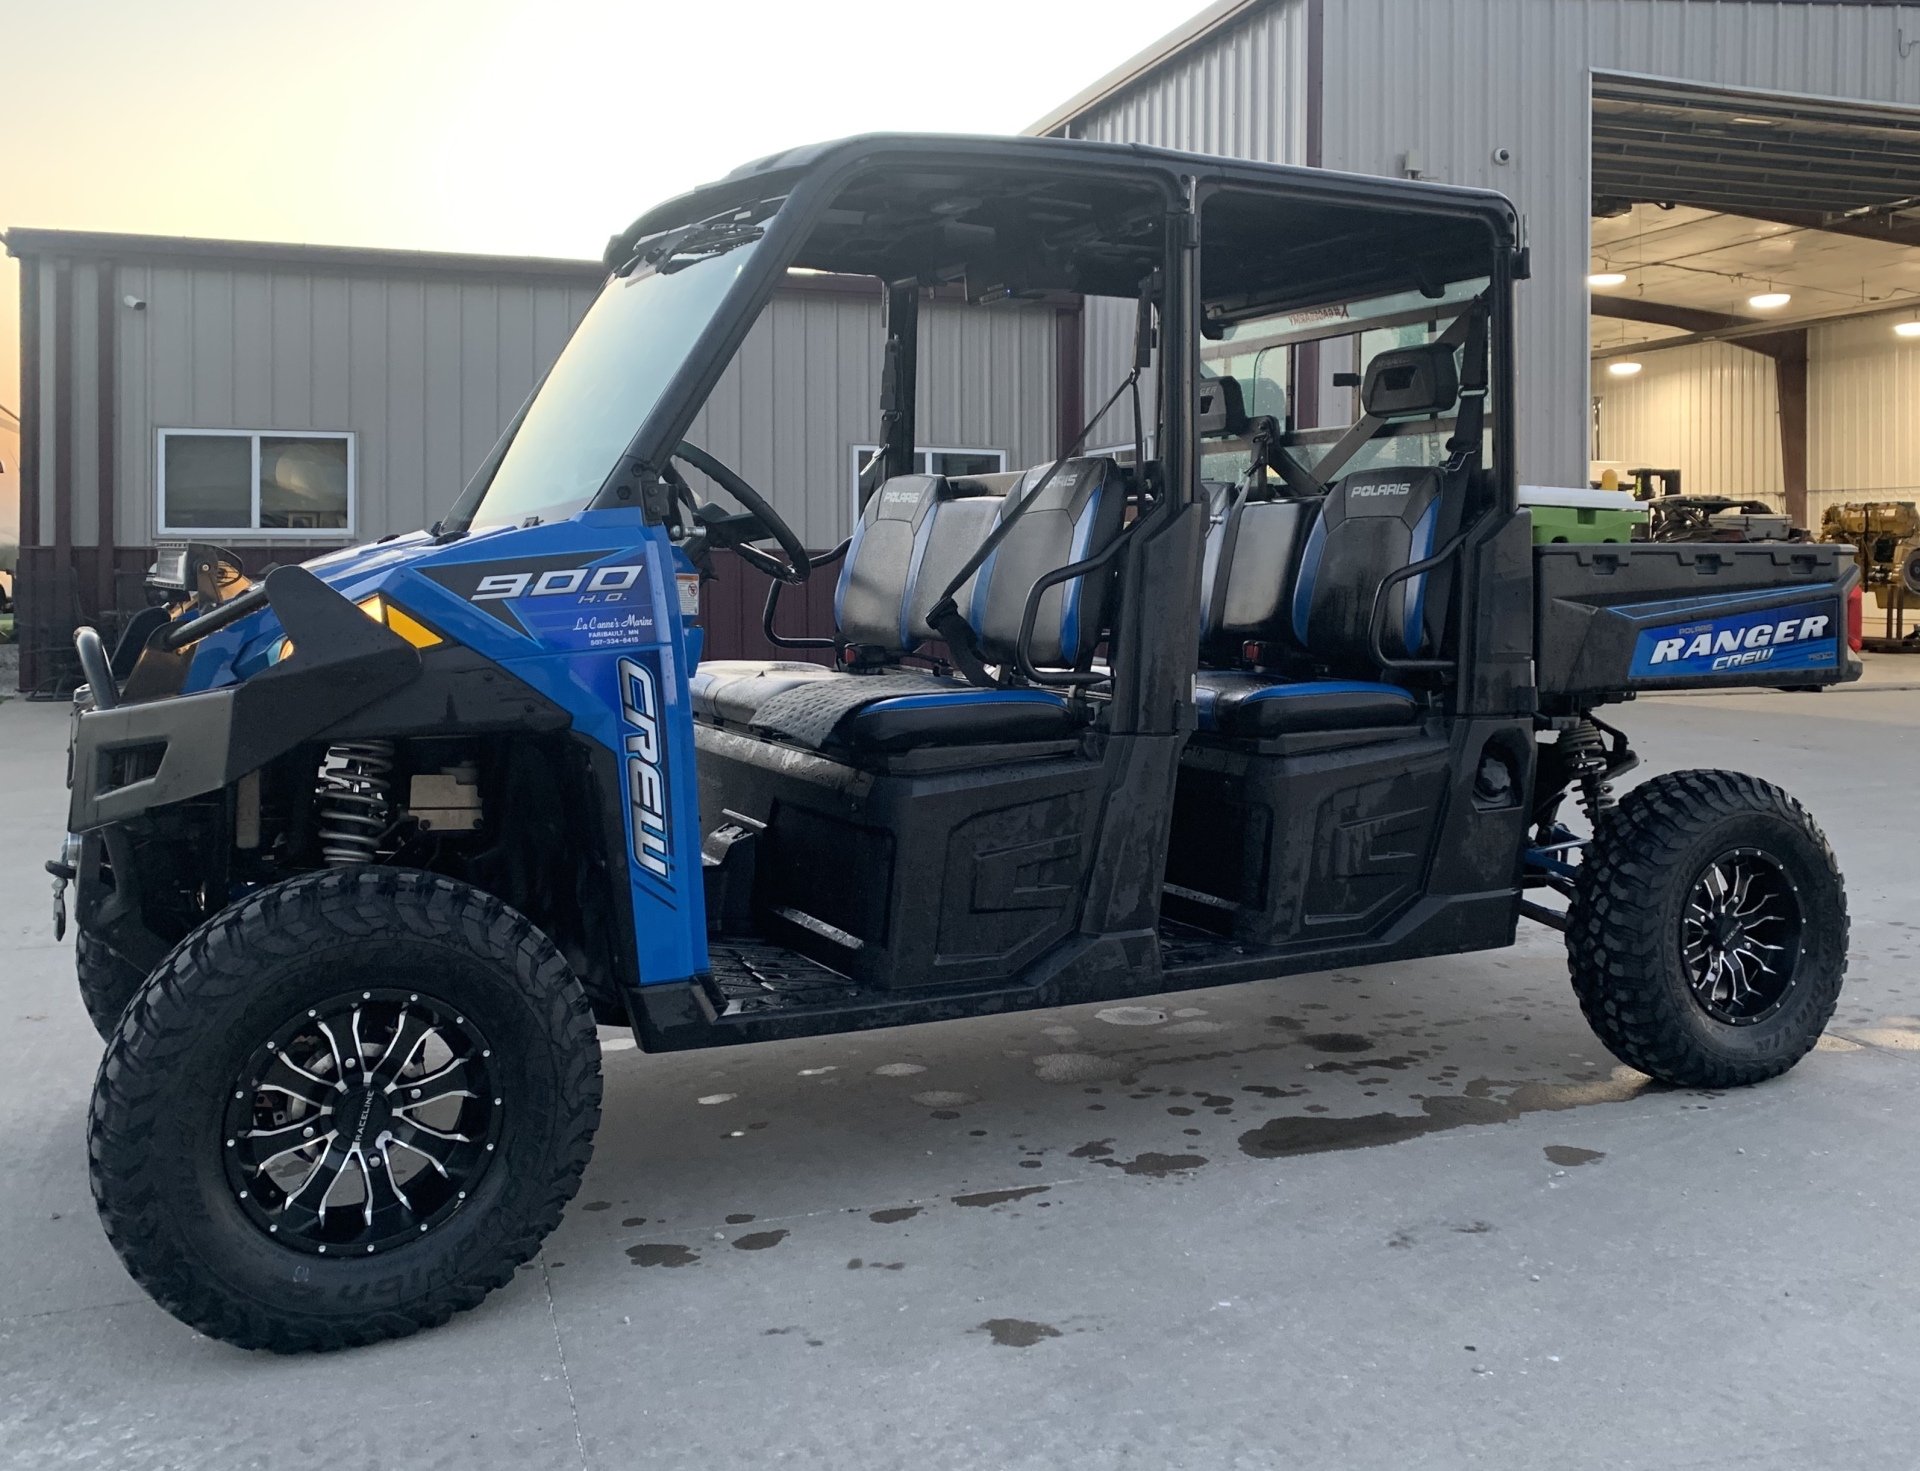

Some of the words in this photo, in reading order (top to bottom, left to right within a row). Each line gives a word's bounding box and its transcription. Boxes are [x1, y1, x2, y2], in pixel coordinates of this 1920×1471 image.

[1027, 474, 1077, 491] PARIS
[1351, 483, 1410, 498] POLARIS
[884, 492, 920, 503] POLARIS
[471, 565, 643, 600] 900
[620, 614, 653, 627] Marine
[1679, 624, 1713, 635] POLARIS
[1649, 615, 1829, 664] RANGER
[1712, 648, 1774, 671] CREW
[617, 656, 669, 880] CREW
[355, 1090, 375, 1141] RACELINE
